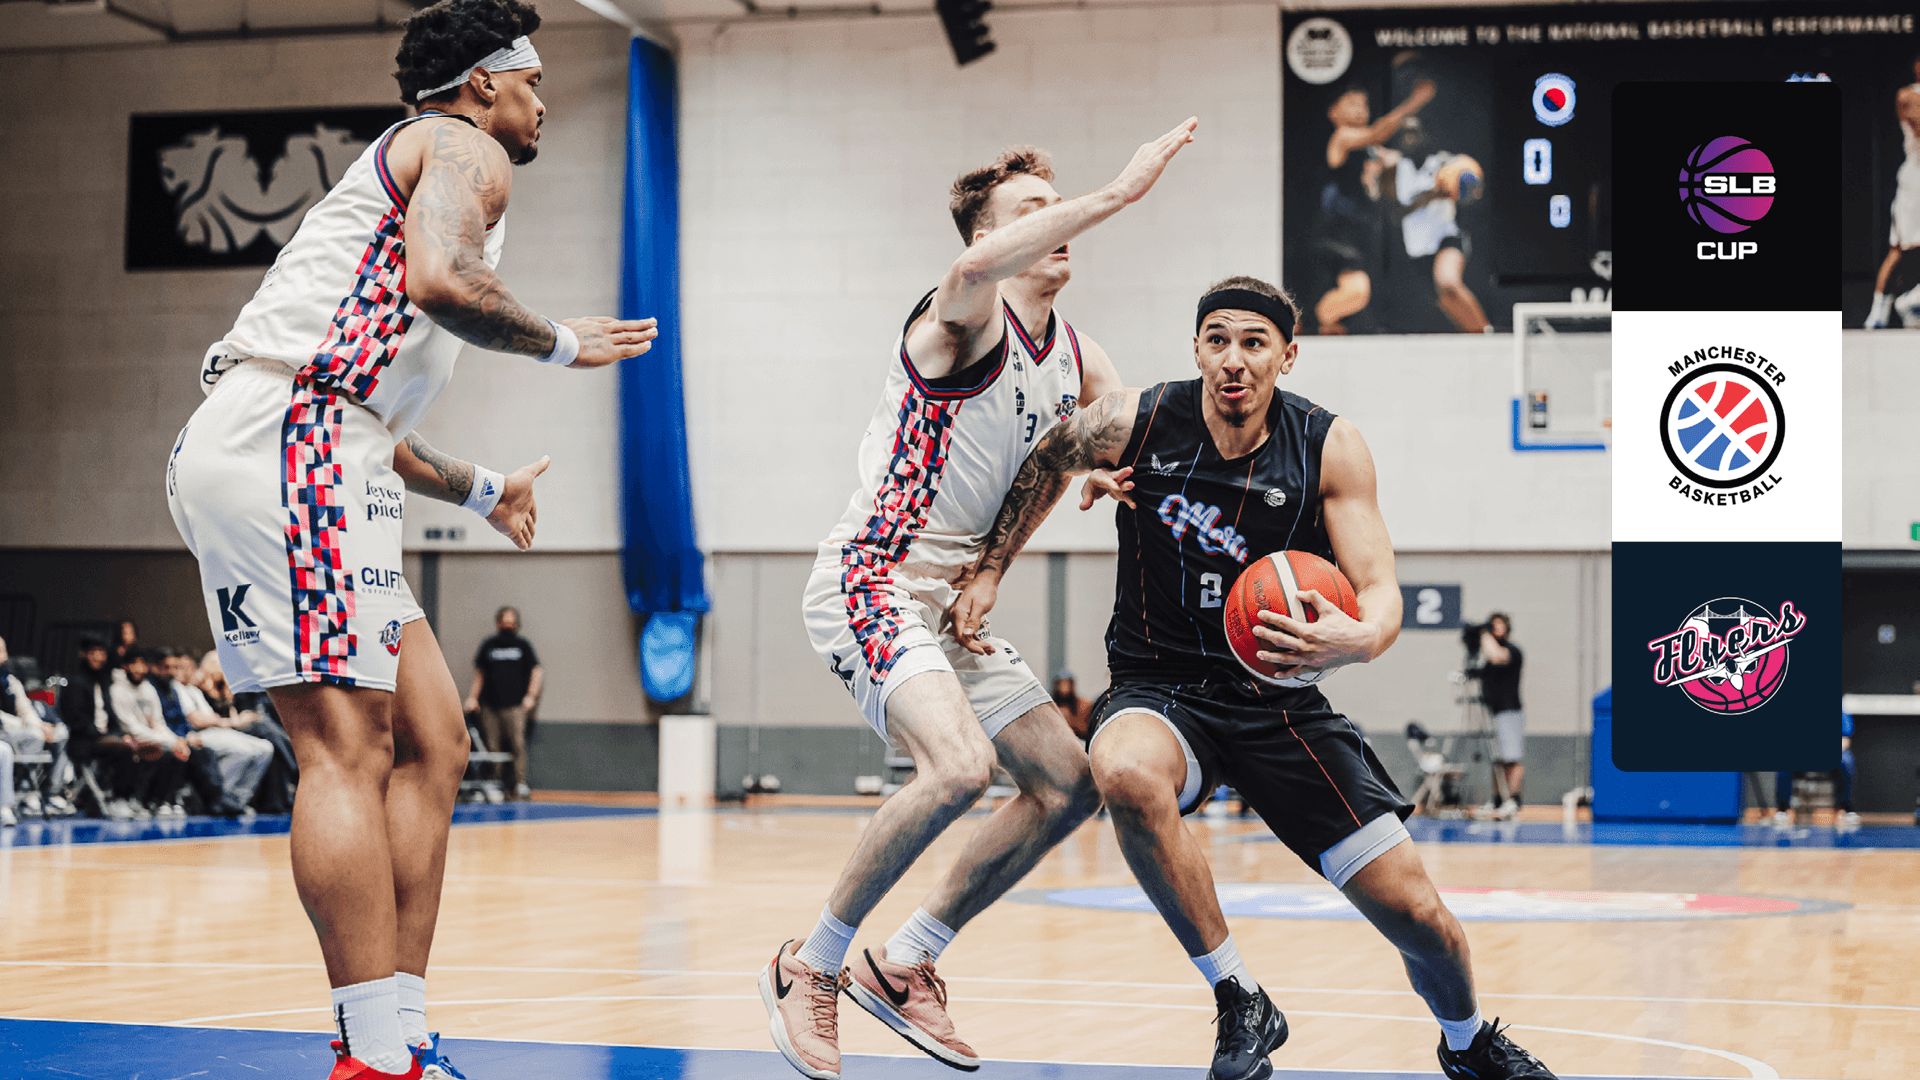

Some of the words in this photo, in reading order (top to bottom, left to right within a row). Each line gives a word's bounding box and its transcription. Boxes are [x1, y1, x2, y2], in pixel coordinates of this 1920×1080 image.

[1375, 26, 1468, 47] WELCOME
[1476, 25, 1500, 44] TO
[1507, 23, 1542, 43] THE
[1548, 21, 1640, 41] NATIONAL
[1647, 18, 1764, 39] BASKETBALL
[1772, 13, 1914, 35] PERFORMANCE
[1024, 413, 1038, 443] 3
[1200, 572, 1222, 609] 2
[1416, 588, 1443, 624] 2
